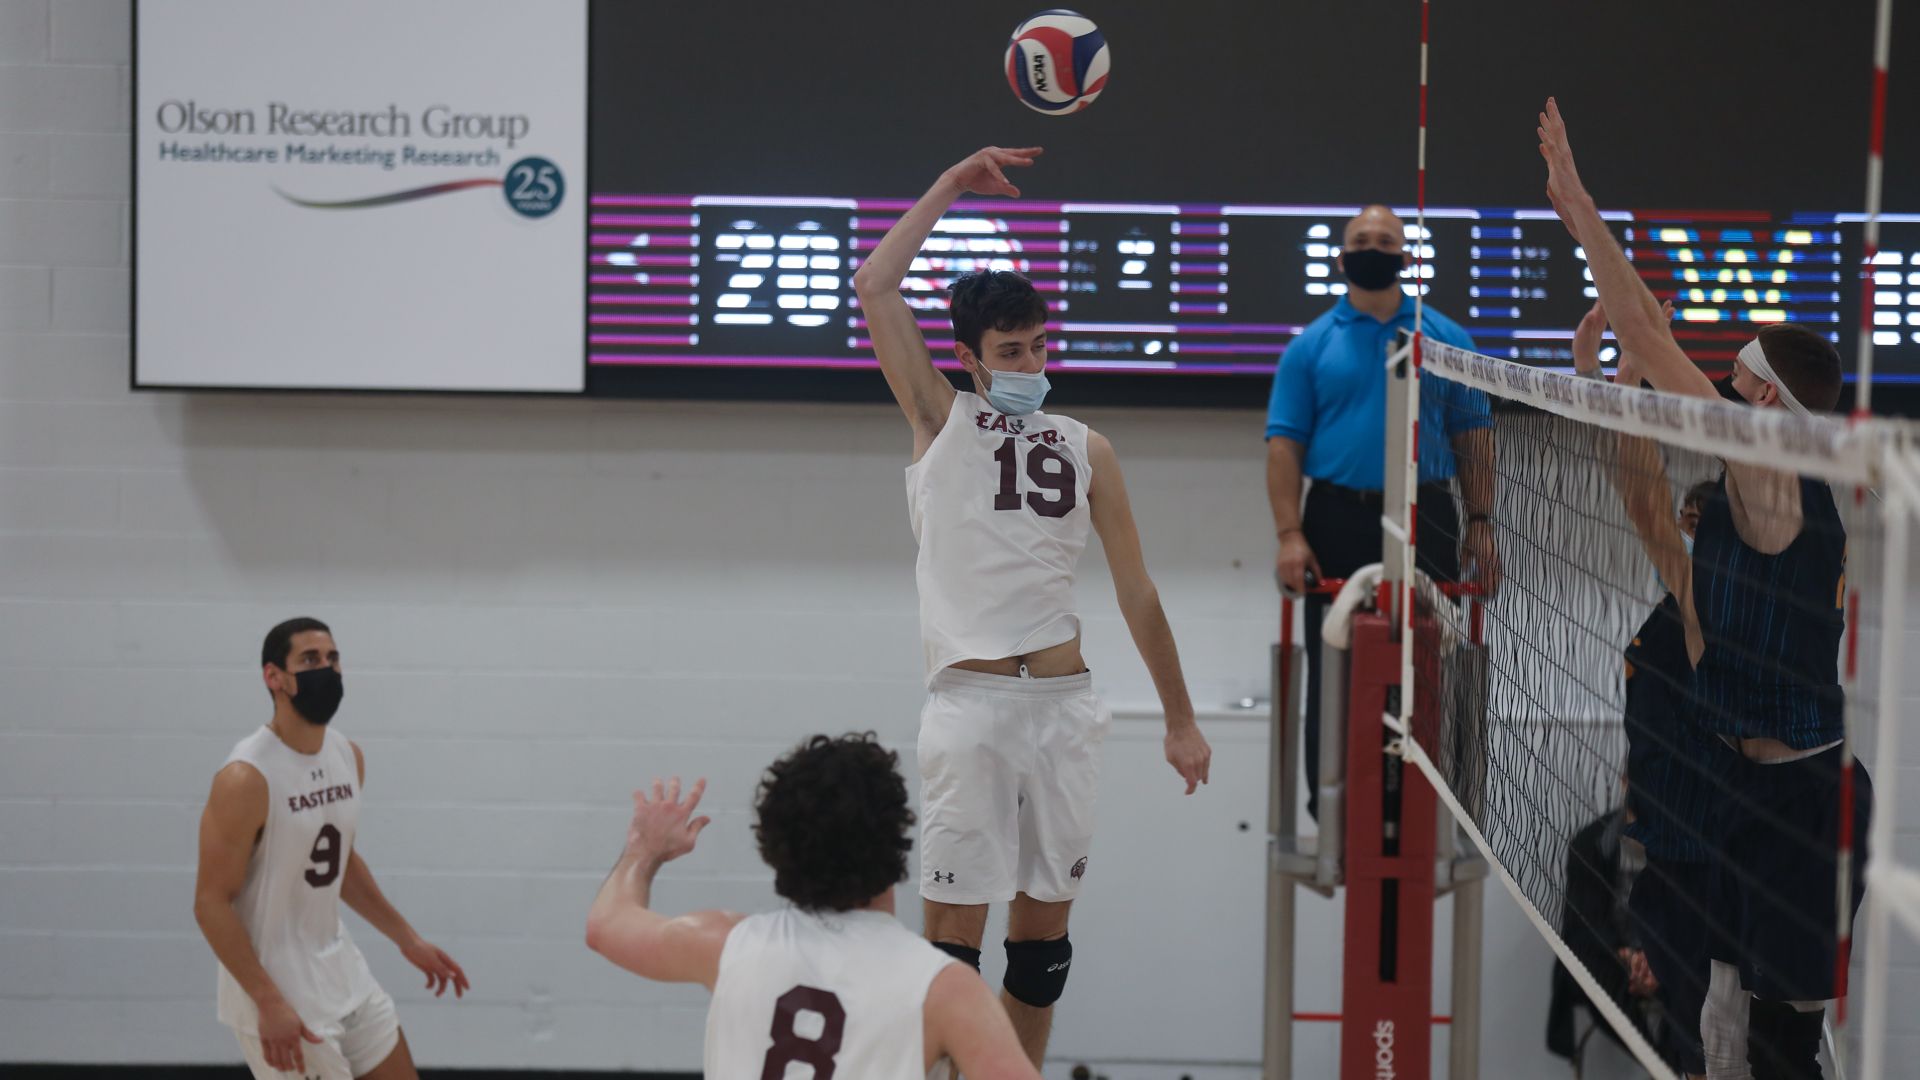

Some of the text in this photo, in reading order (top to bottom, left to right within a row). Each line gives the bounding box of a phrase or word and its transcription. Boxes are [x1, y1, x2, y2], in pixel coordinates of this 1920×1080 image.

[157, 100, 530, 149] Olson Research Group
[159, 142, 501, 171] Healthcare Marketing Research
[512, 165, 558, 201] 25
[994, 437, 1077, 519] 19
[288, 783, 353, 813] EASTERN
[304, 823, 342, 888] 9
[760, 984, 847, 1080] 8
[1373, 1019, 1396, 1080] sport
